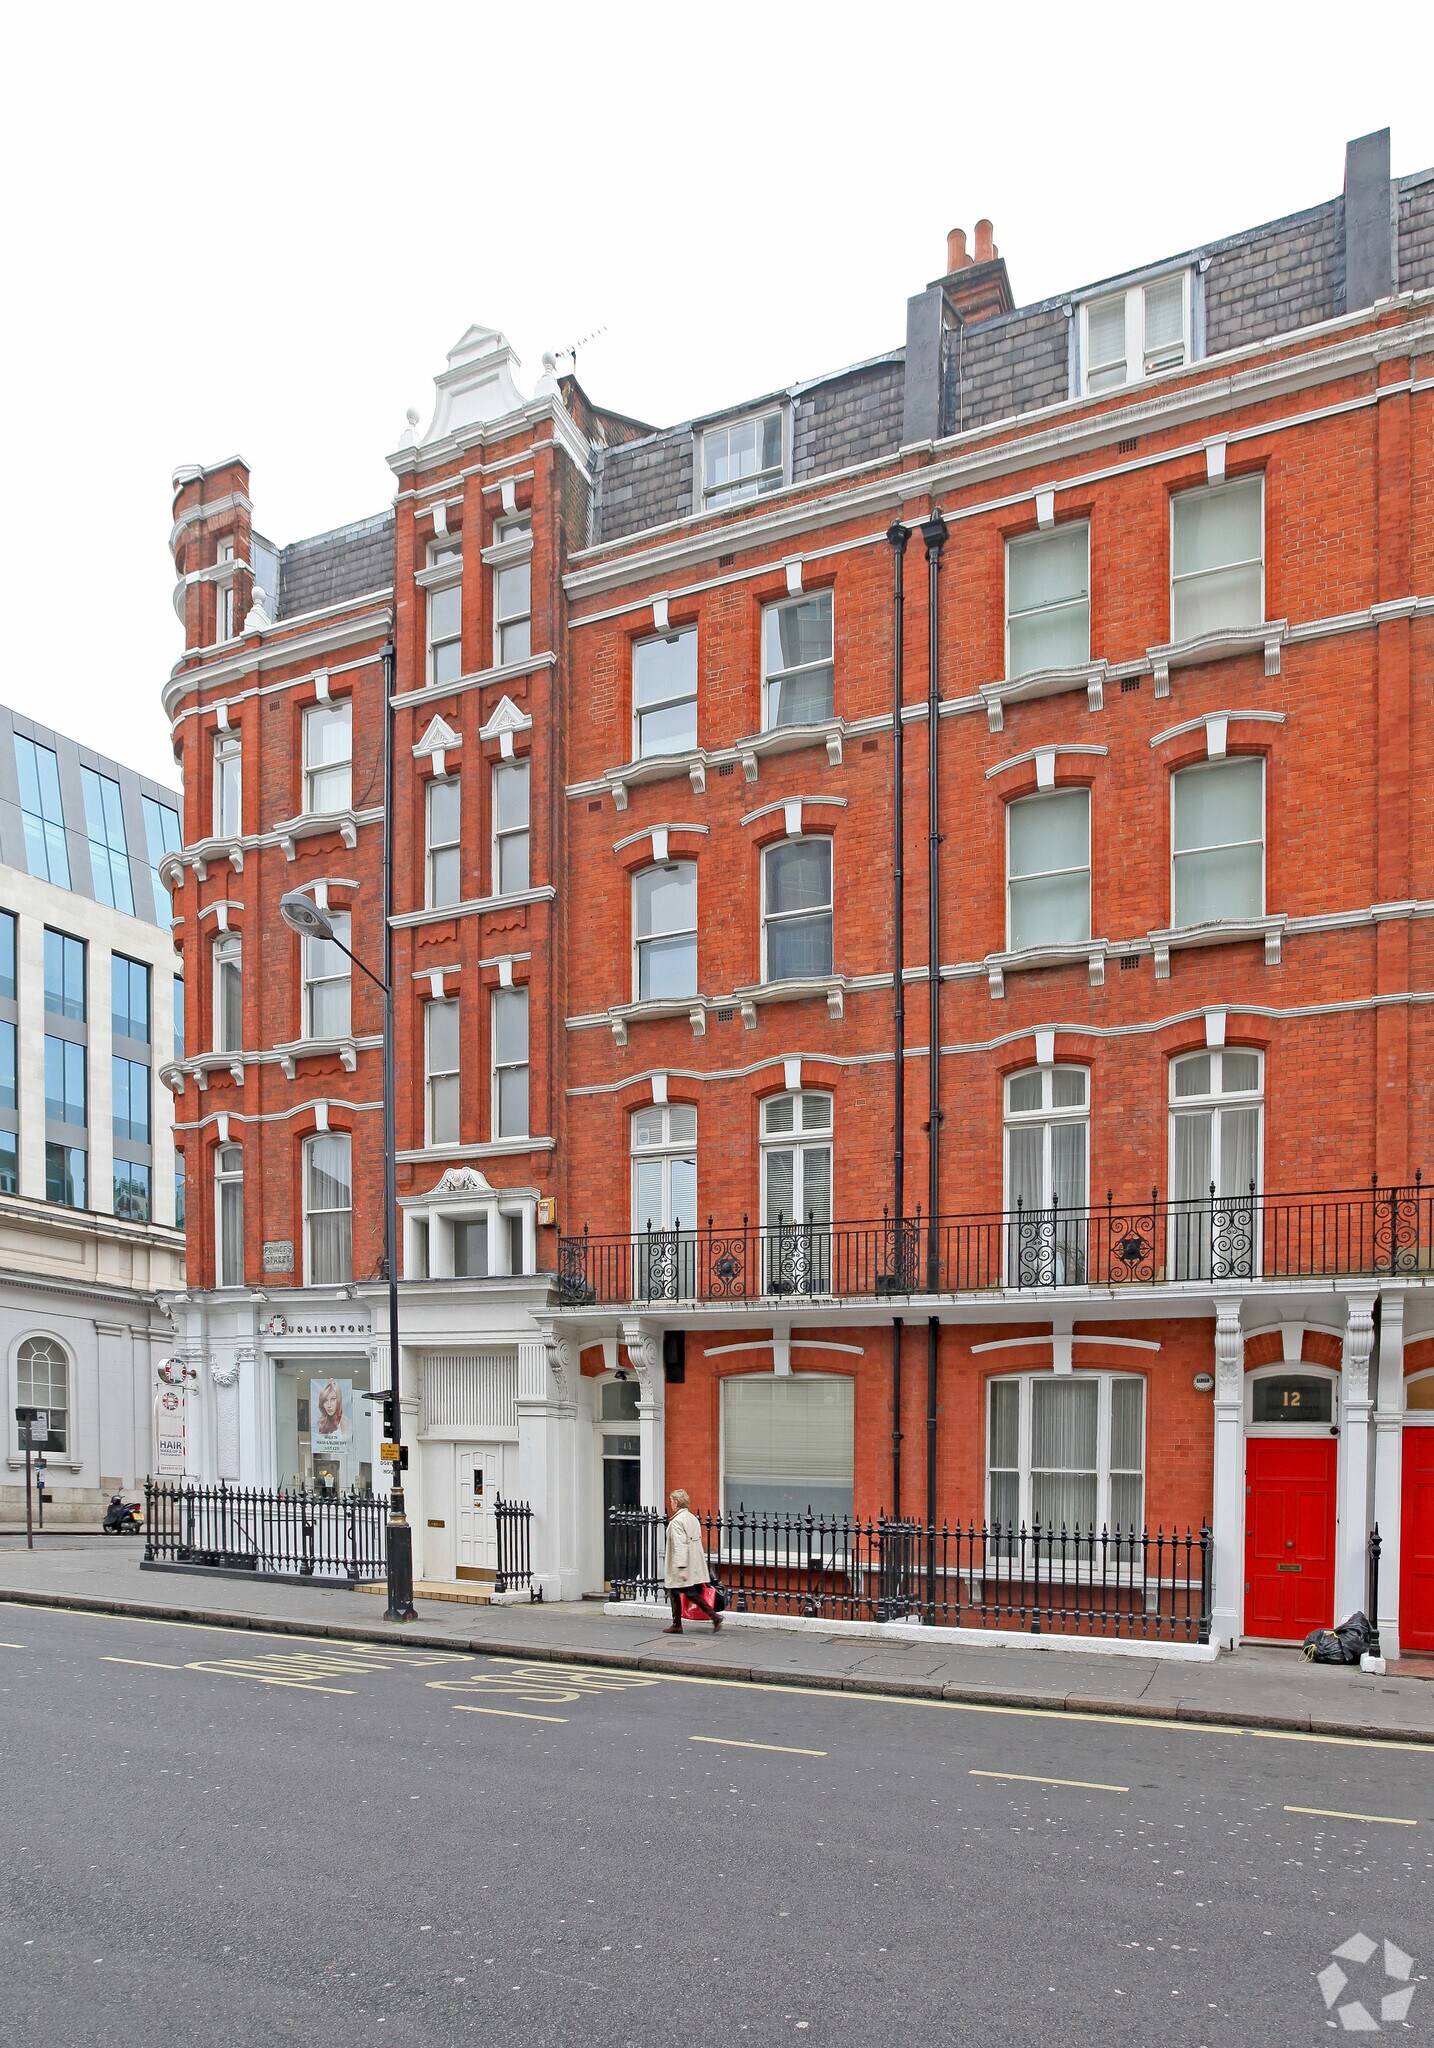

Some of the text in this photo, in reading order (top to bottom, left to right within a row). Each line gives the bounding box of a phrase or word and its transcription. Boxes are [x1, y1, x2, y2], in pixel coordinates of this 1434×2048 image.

[1283, 1391, 1301, 1406] 12
[160, 1440, 182, 1449] HAIR
[623, 1441, 632, 1450] 13
[425, 1667, 661, 1703] BUS
